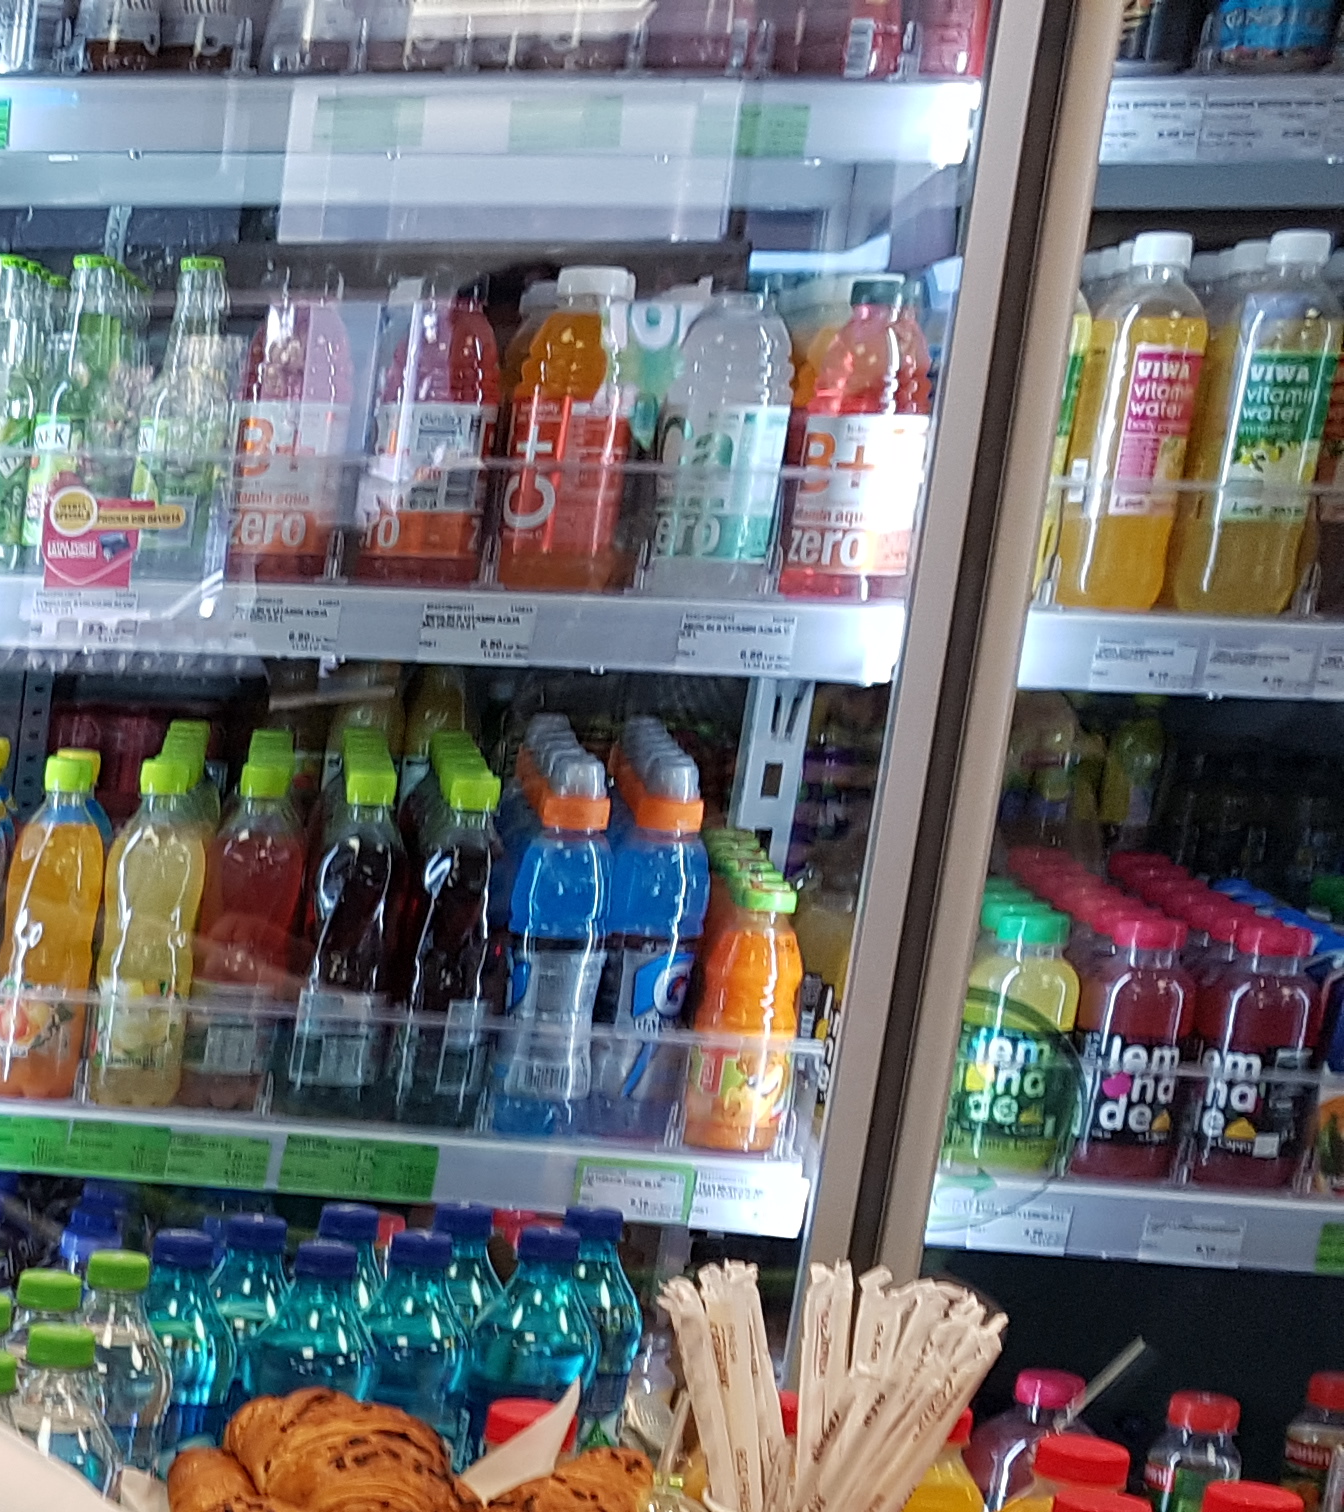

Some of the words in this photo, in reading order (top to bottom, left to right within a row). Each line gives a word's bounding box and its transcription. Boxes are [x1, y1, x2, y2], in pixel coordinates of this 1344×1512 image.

[1137, 361, 1191, 379] VIWA
[1250, 364, 1310, 382] VIWA
[789, 529, 868, 567] zero
